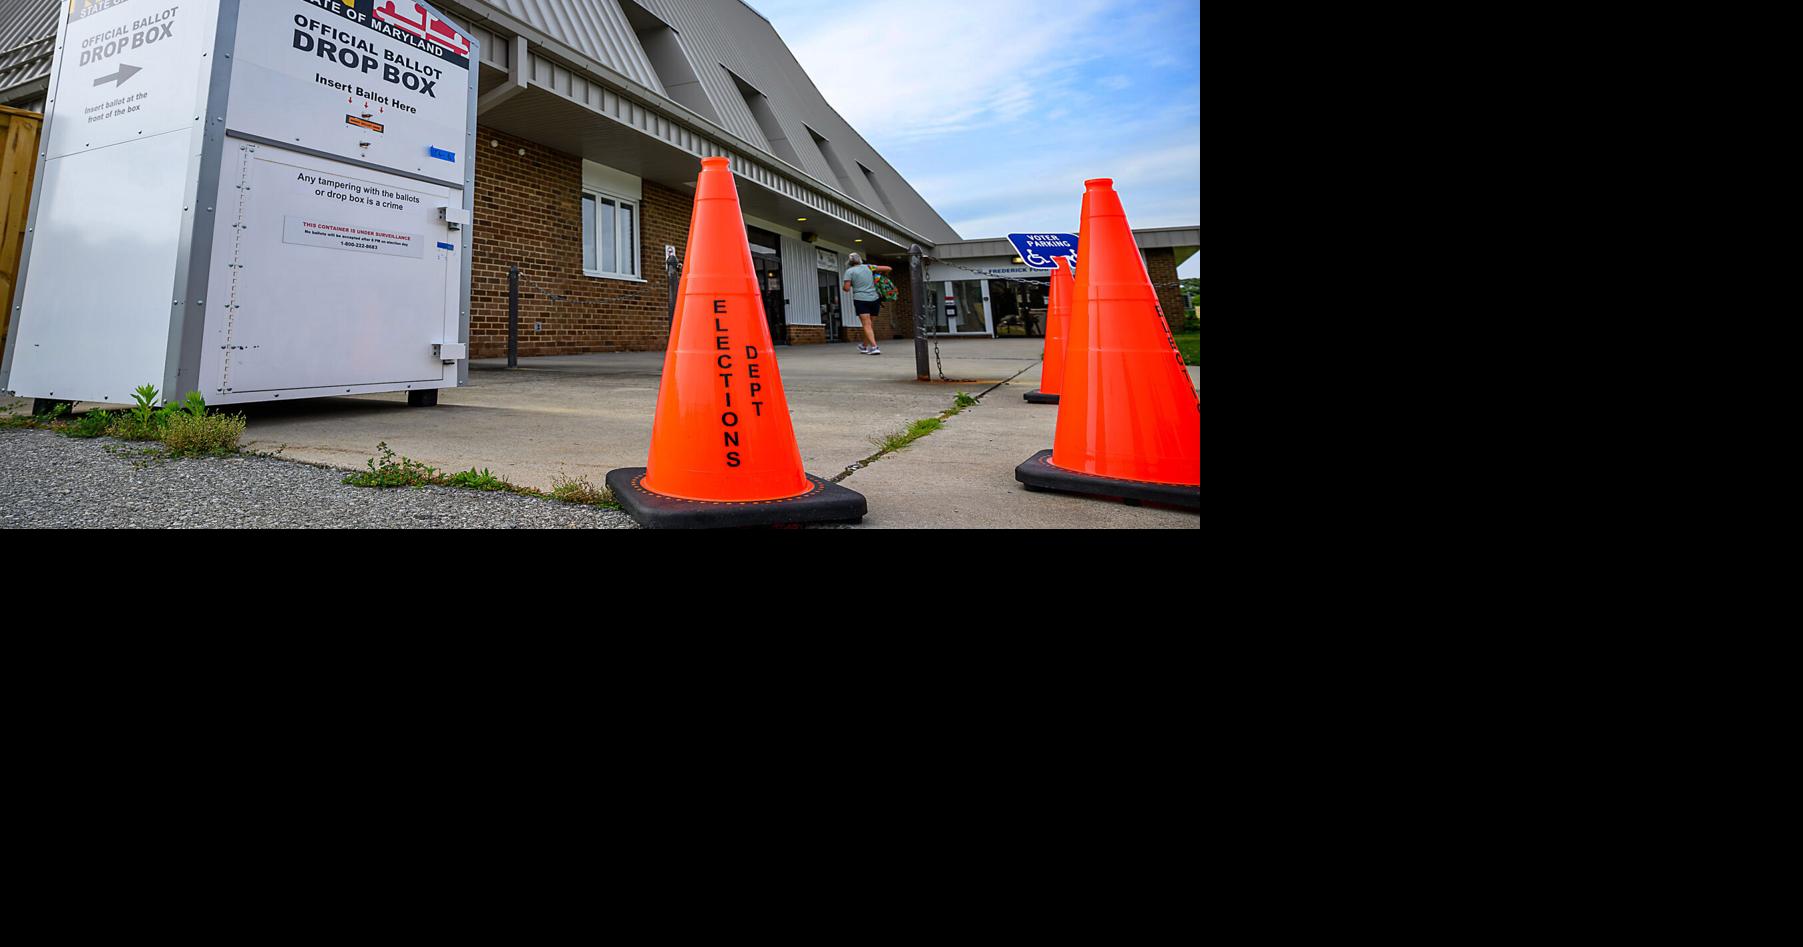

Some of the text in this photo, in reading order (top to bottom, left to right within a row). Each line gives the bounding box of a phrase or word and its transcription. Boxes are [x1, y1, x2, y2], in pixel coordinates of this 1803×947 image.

[80, 21, 174, 67] DROP BOX
[82, 6, 179, 48] OFFICIAL BALLOT
[294, 14, 442, 80] OFFICIAL BALLOT
[347, 8, 366, 23] OF
[371, 18, 443, 57] MARYLAND
[293, 29, 436, 98] DROP BOX
[84, 91, 148, 114] Insert ballot at the
[88, 105, 141, 123] front of the box
[315, 73, 417, 114] Insert Ballot Here
[297, 173, 420, 204] Any tampering with the ballots
[327, 190, 347, 201] drop
[349, 195, 364, 204] box
[366, 197, 374, 206] is
[382, 201, 404, 211] crime
[318, 224, 350, 232] CONTAINER
[375, 232, 411, 241] SURVEILLANCE
[714, 300, 741, 468] ELECTIONS
[746, 345, 763, 417] DEPT
